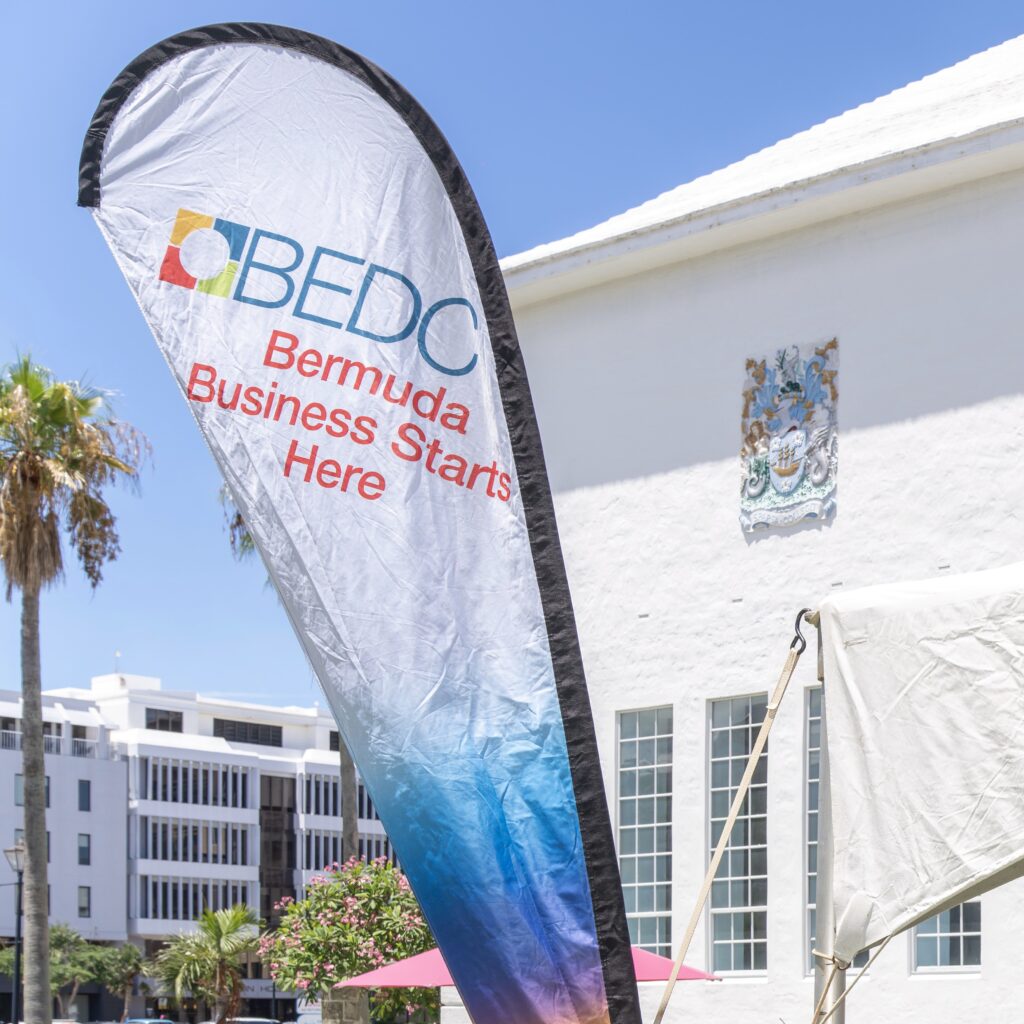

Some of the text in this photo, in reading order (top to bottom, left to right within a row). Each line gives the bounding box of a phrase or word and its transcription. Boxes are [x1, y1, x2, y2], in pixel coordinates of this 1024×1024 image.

[233, 228, 478, 377] BEDC
[187, 362, 512, 502] Business Starts
[263, 329, 470, 435] Bermuda
[283, 440, 386, 501] Here
